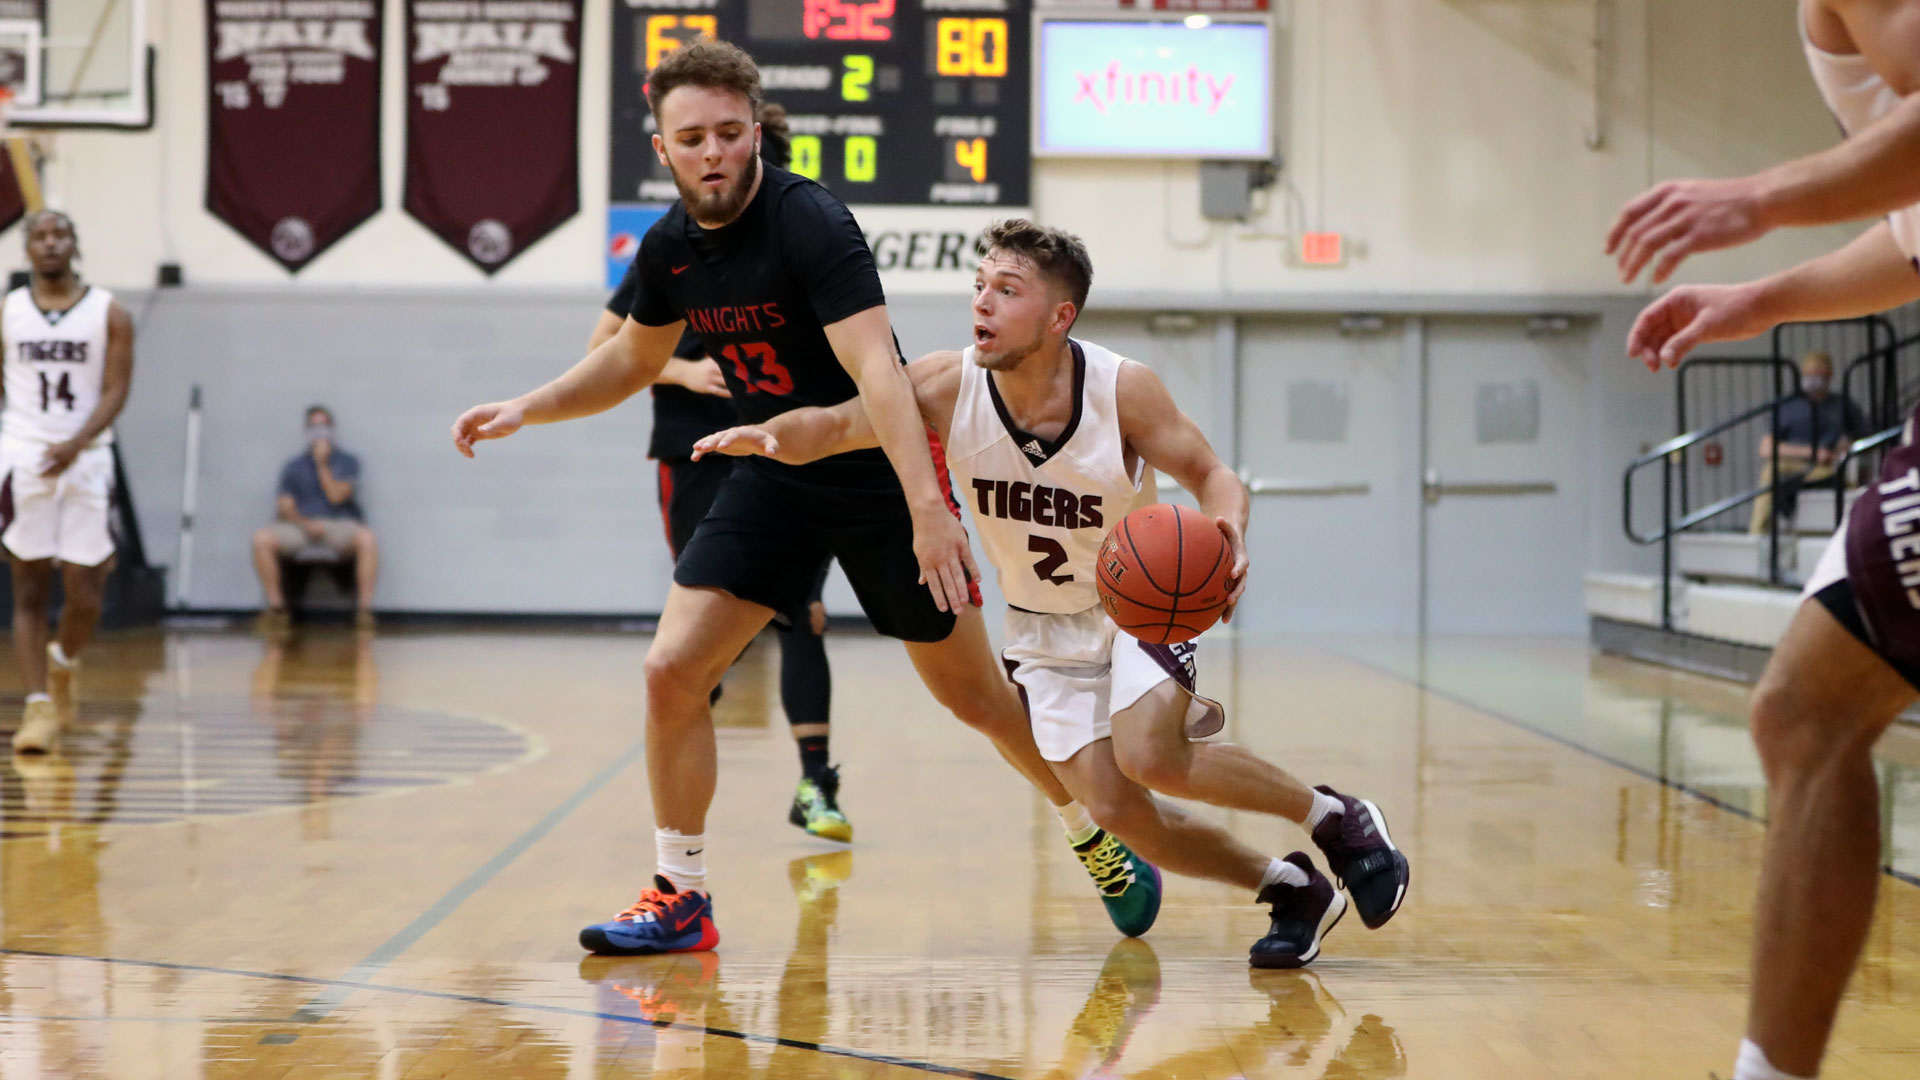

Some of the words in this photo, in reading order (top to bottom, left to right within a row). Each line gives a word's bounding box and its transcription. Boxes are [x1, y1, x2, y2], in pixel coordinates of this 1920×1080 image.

[215, 21, 376, 62] NAIA
[413, 22, 575, 63] NAIA
[936, 17, 1008, 77] 80
[842, 55, 874, 101] 2
[1073, 61, 1236, 115] xfinity
[955, 137, 987, 183] 4
[687, 303, 785, 333] KNIGHTS
[18, 341, 88, 363] TIGERS
[721, 342, 794, 395] 13
[39, 371, 75, 411] 14
[972, 478, 1103, 529] TIGERS
[1028, 534, 1074, 586] 2
